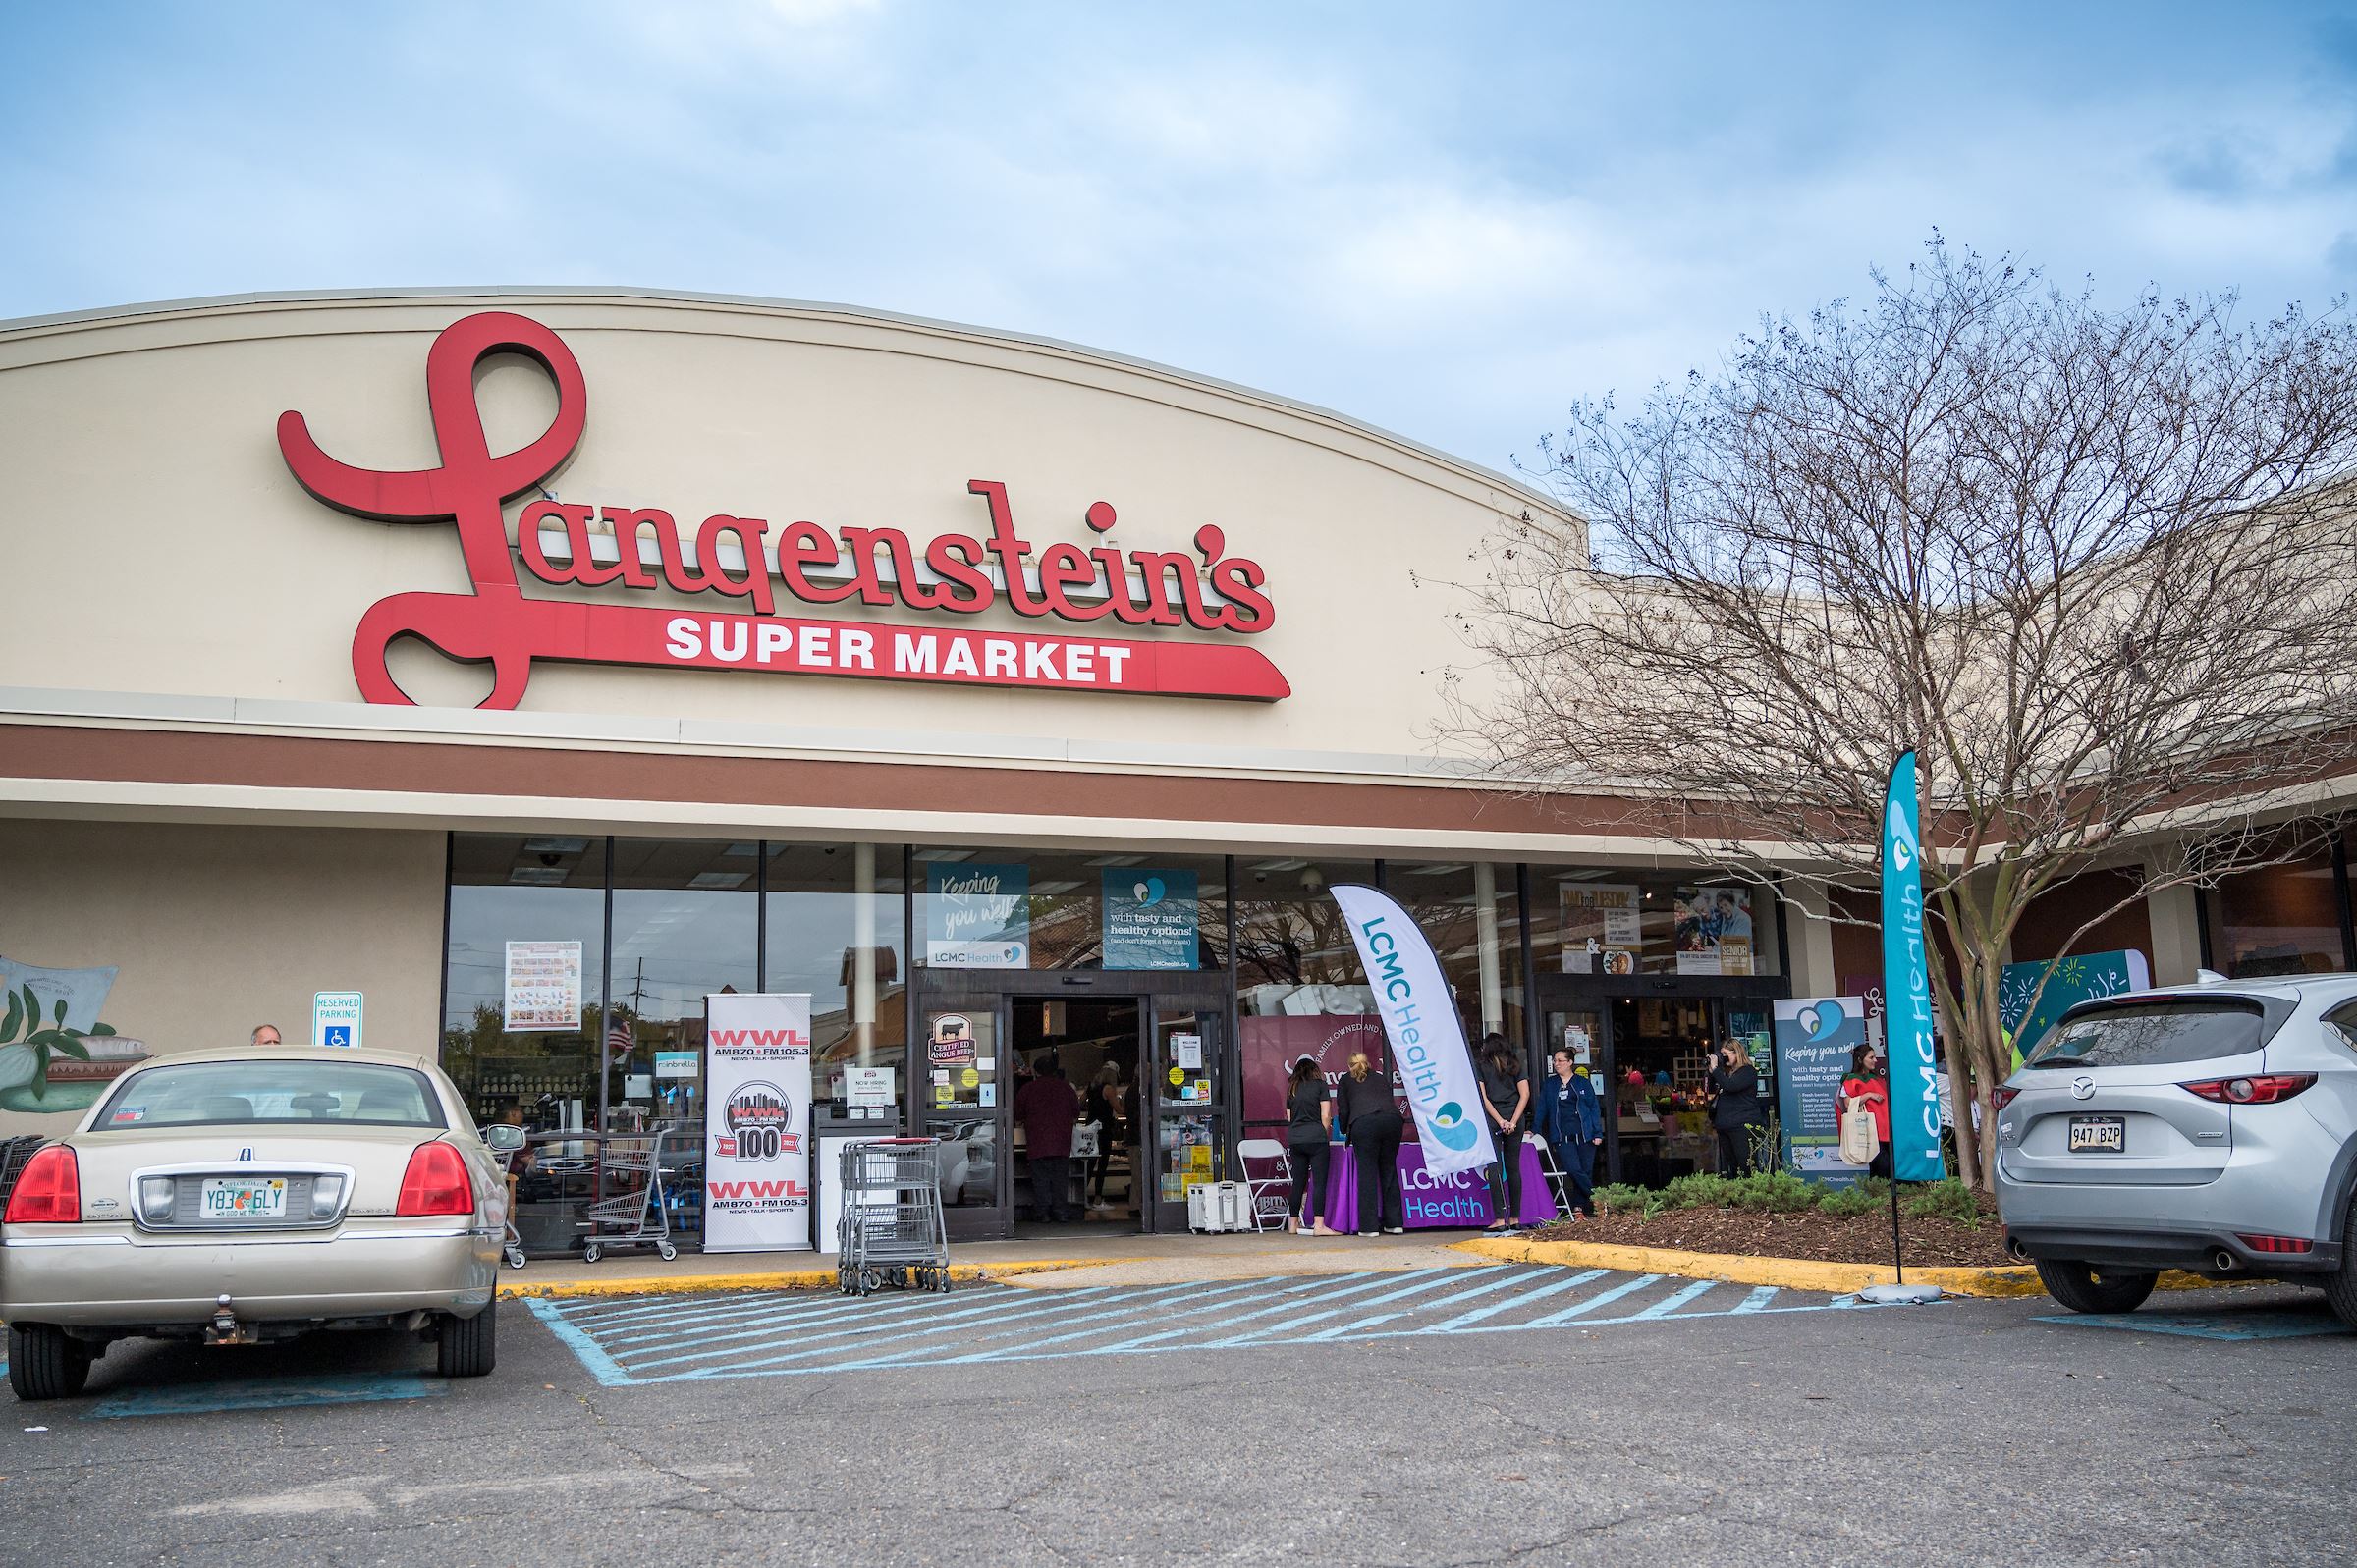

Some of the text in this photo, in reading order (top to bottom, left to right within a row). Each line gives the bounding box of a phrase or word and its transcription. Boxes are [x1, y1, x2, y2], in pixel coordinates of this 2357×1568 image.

[277, 311, 1277, 710] Langenstein's
[666, 617, 1132, 685] SUPER MARKET
[941, 871, 1001, 906] Keeping
[945, 895, 1021, 940] you well
[1110, 912, 1182, 924] with tasty and
[1110, 925, 1192, 937] healthy options!
[1585, 937, 1601, 955] &
[1722, 946, 1747, 956] SENIOR
[935, 952, 1002, 963] LCMC Health
[317, 999, 359, 1007] RESERVED
[1362, 916, 1442, 1103] LCMC Health
[320, 1010, 356, 1019] PARKING
[934, 1041, 970, 1052] CERTIFIED
[1315, 1023, 1379, 1063] FAMILY OWNED AND
[1784, 1045, 1818, 1063] Keeping
[1819, 1046, 1837, 1061] you
[1837, 1042, 1855, 1054] well
[1915, 1031, 1941, 1159] LCMC
[738, 1129, 778, 1158] 100
[2073, 1127, 2120, 1143] 947 BZP
[1400, 1168, 1472, 1190] LCMC
[207, 1190, 235, 1209] Y83
[712, 1200, 753, 1209] AM870
[1405, 1195, 1484, 1219] Health
